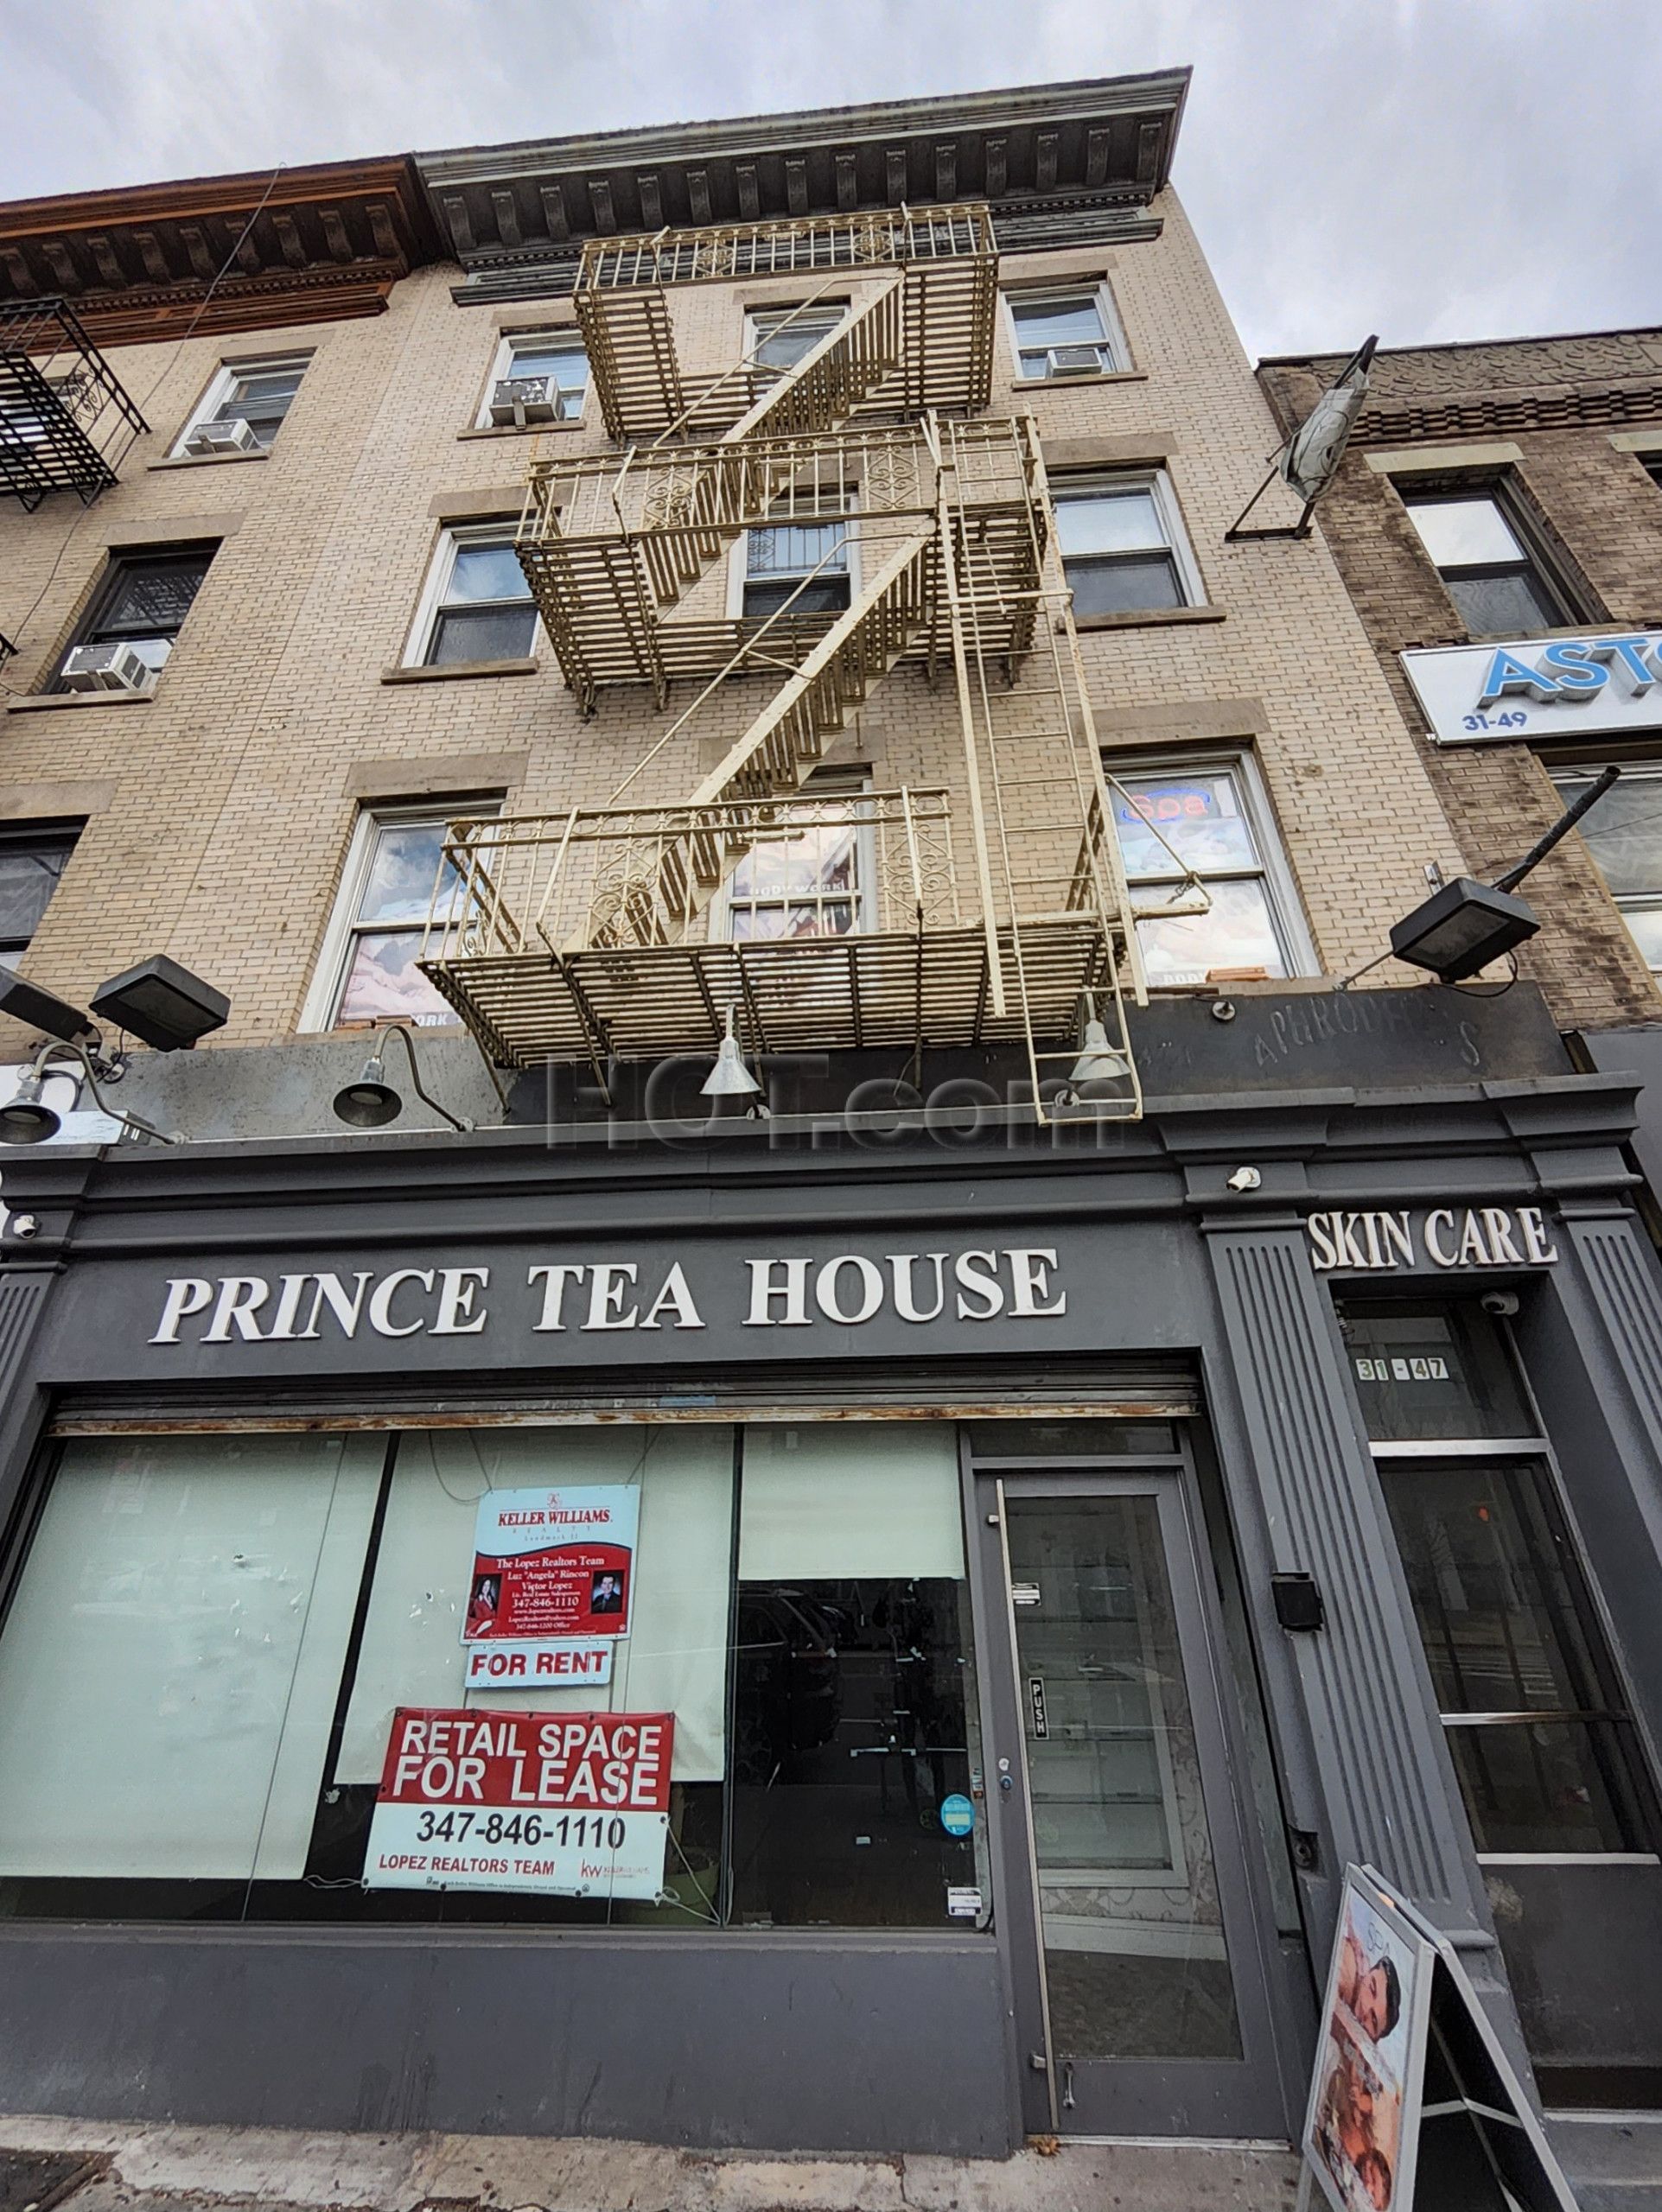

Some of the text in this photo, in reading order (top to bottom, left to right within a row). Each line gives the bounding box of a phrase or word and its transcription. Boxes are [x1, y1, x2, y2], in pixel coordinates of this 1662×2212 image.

[1482, 638, 1662, 696] AST
[1461, 711, 1528, 731] 31-49
[1129, 794, 1209, 821] Spa
[412, 1013, 449, 1027] ORK
[1307, 1207, 1559, 1271] SKIN CARE
[147, 1248, 1067, 1344] PRINCE TEA HOUSE
[498, 1510, 545, 1527] KELLER
[496, 1555, 605, 1571] The Lopez Realtors Team
[506, 1569, 589, 1581] Luz "Angela" Rincon
[521, 1580, 573, 1592] Victor Lopez
[512, 1596, 580, 1609] 347-846-1110
[470, 1650, 608, 1677] FOR RENT
[1033, 1683, 1046, 1734] PUSH
[400, 1719, 663, 1761] RETAIL SPACE
[392, 1755, 660, 1805] FOR LEASE
[416, 1810, 627, 1850] 347-846-1110
[379, 1853, 556, 1876] LOPEZ REALTORS TEAM
[581, 1859, 603, 1878] kw
